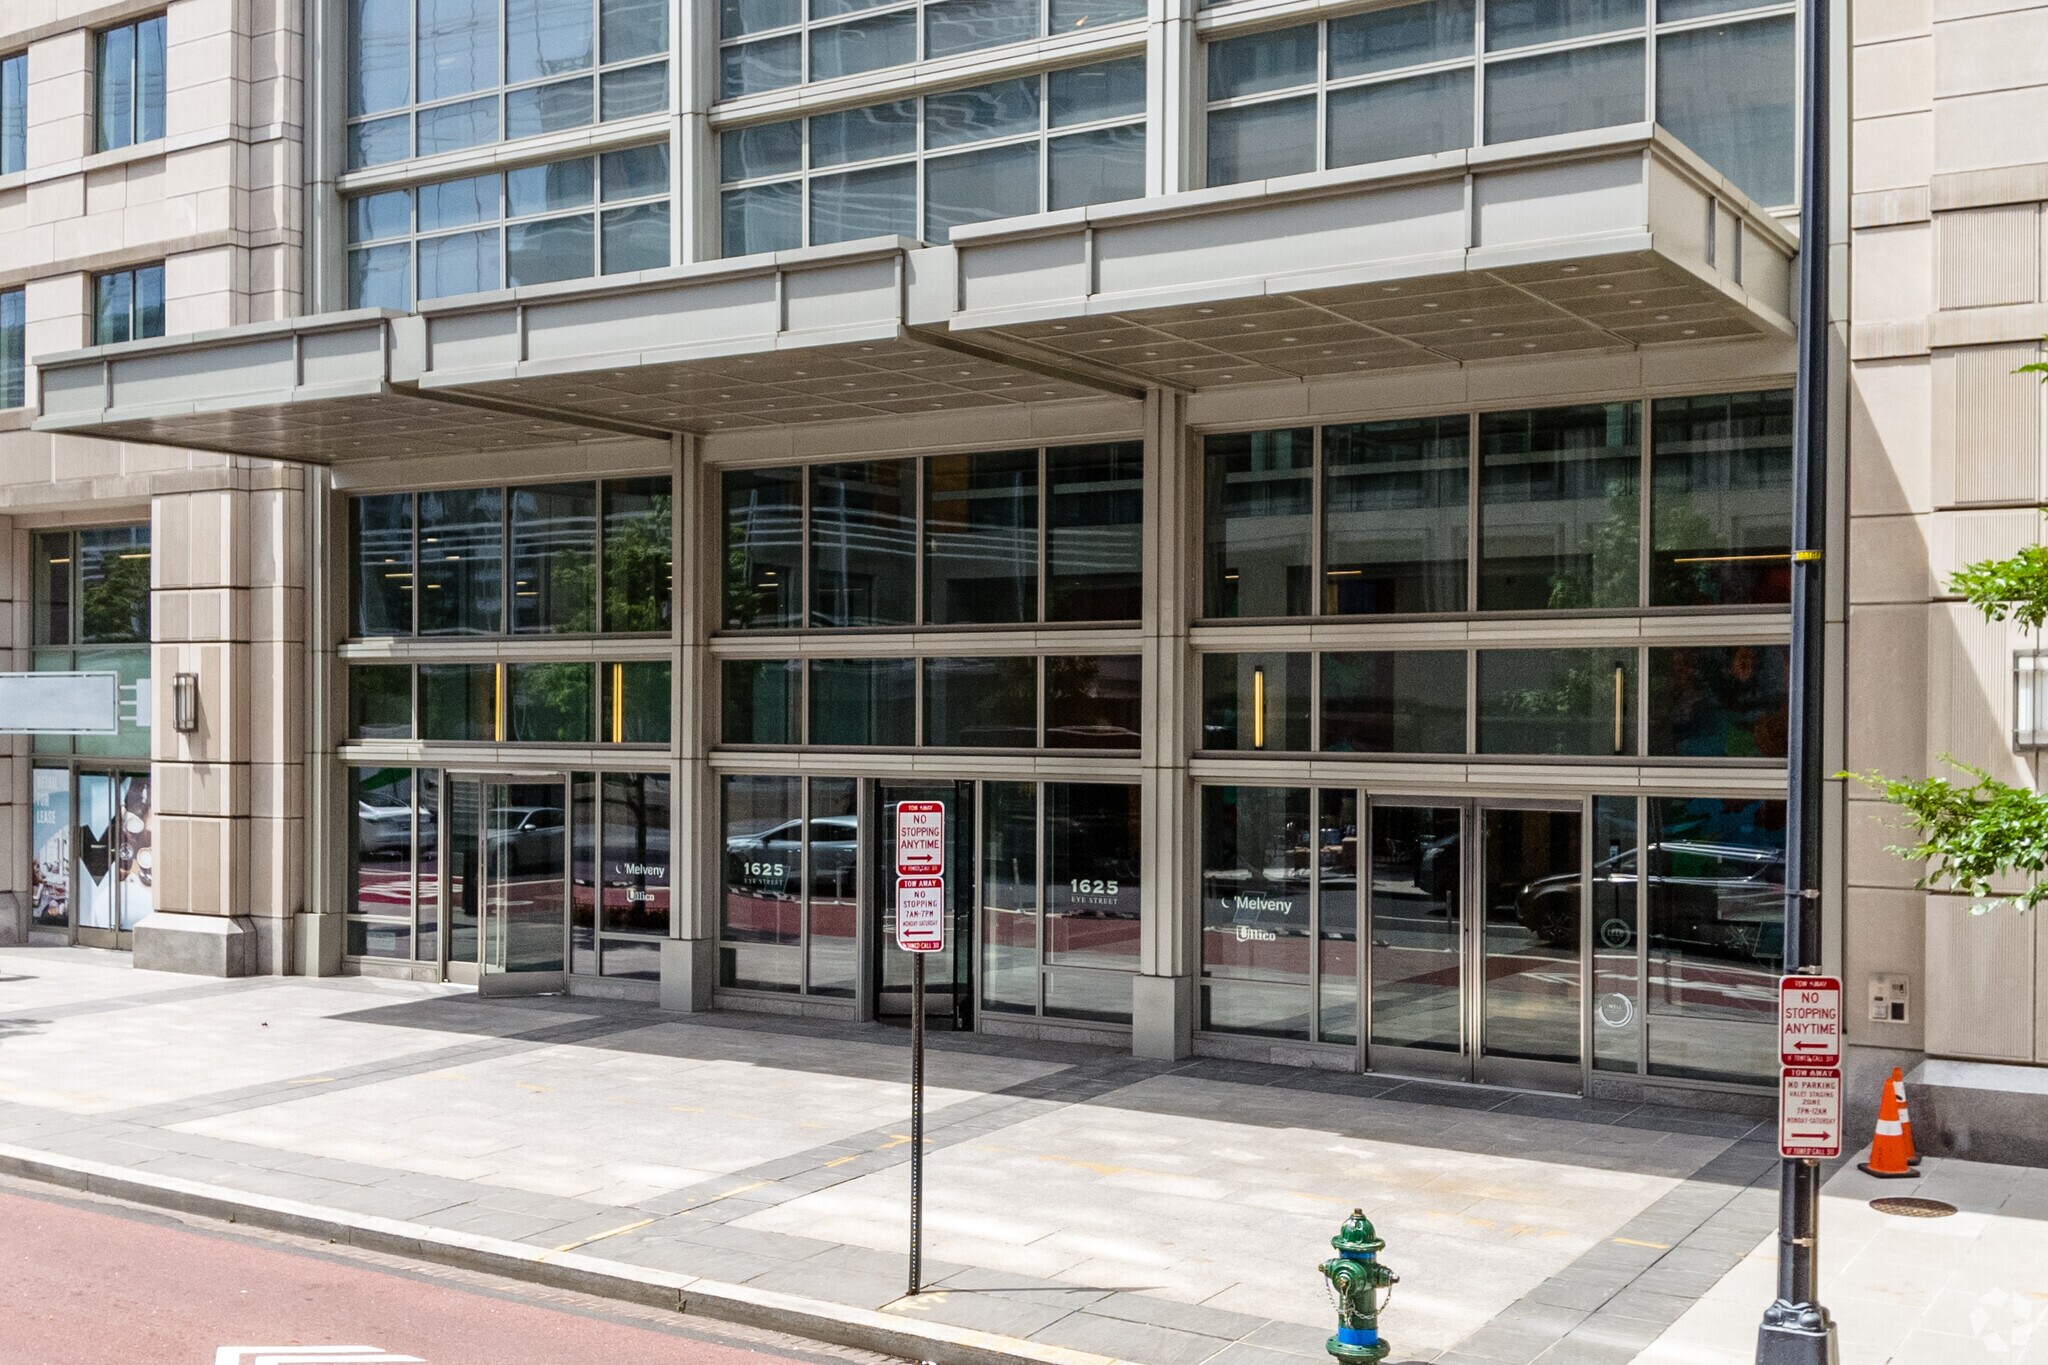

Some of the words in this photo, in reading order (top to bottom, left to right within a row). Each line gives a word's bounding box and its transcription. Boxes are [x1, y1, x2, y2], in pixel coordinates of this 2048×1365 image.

[37, 810, 56, 824] LEASE
[914, 815, 926, 824] NO
[901, 827, 939, 837] STOPPING
[901, 840, 939, 849] ANYTIME
[744, 862, 783, 876] 1625
[1071, 879, 1119, 895] 1625
[1802, 992, 1819, 1004] NO
[1786, 1008, 1836, 1019] STOPPING
[1785, 1023, 1836, 1034] ANYTIME
